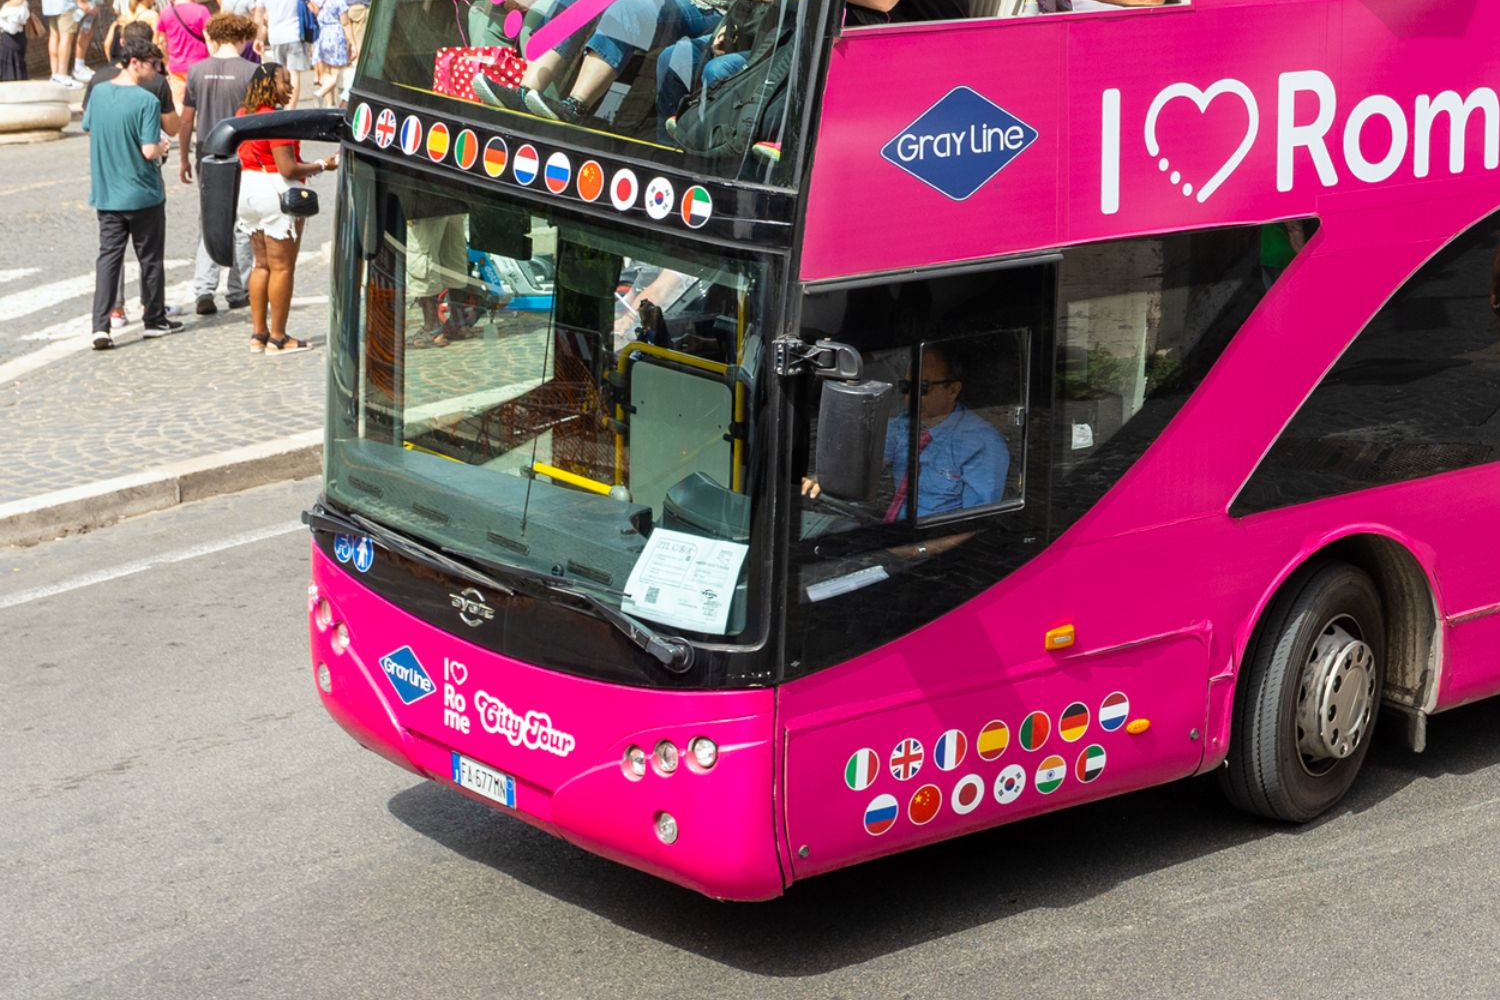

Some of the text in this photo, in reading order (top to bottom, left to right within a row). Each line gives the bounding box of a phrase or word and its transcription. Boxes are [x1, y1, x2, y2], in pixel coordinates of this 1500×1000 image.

[1100, 87, 1121, 215] I
[443, 656, 450, 681] I
[443, 682, 466, 712] Ro
[443, 708, 470, 735] me
[475, 690, 575, 757] City Tour
